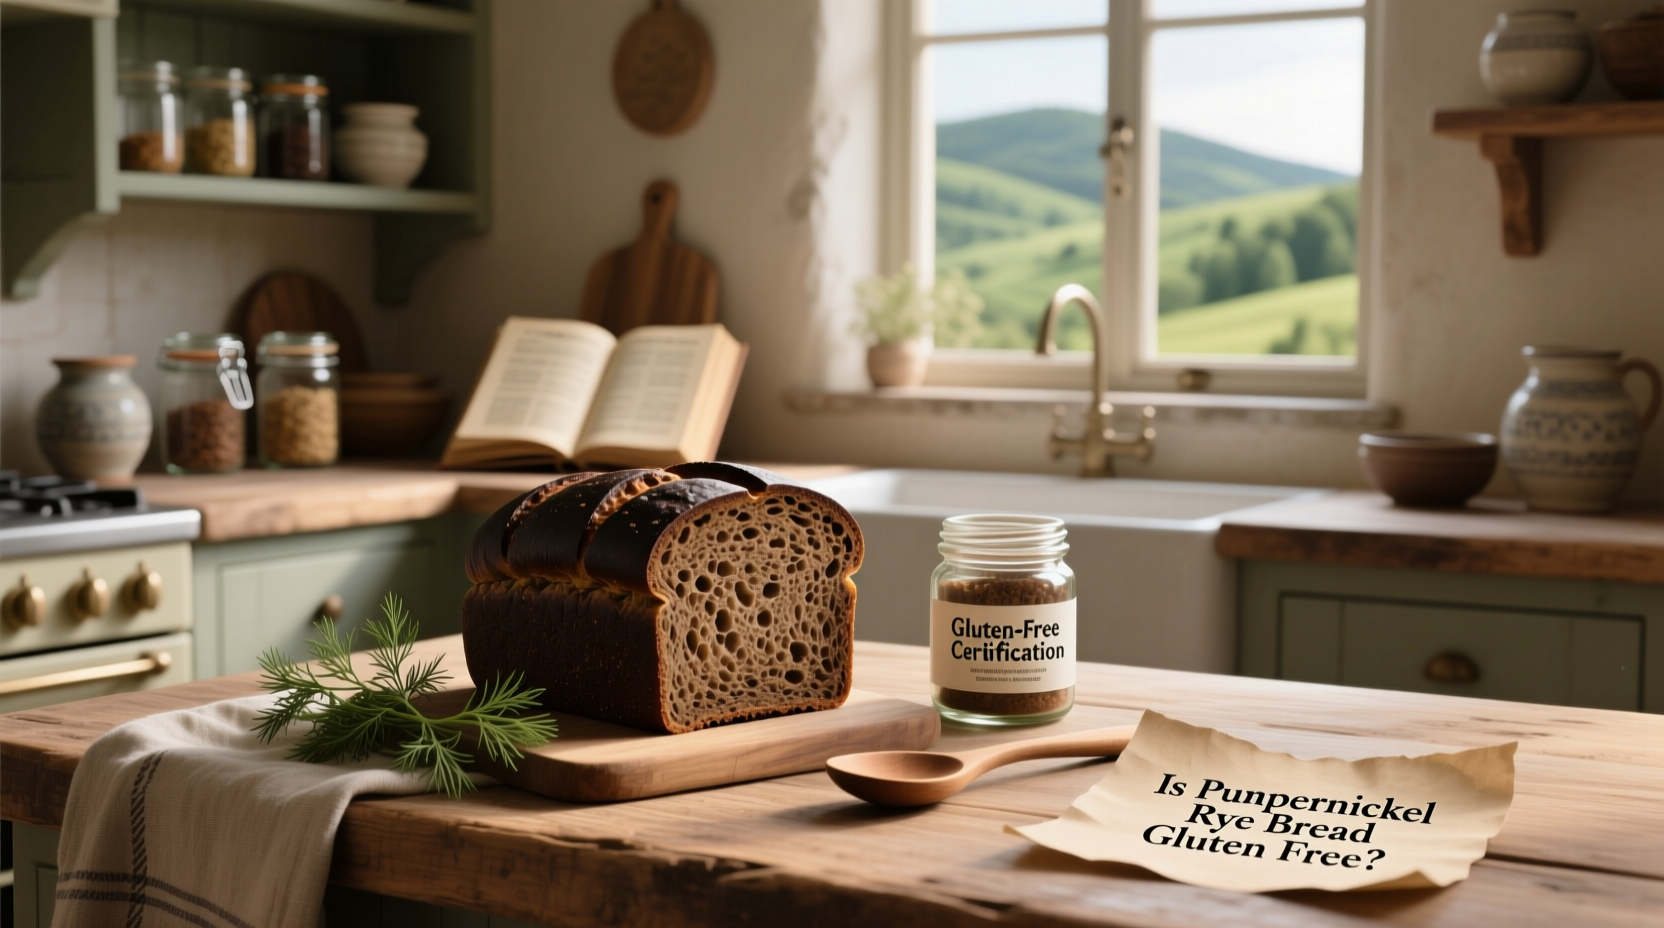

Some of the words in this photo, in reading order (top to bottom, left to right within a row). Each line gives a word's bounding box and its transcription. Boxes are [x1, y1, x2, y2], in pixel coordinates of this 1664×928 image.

[951, 617, 1060, 639] Gluten-Free
[1154, 773, 1187, 797] Is
[1195, 779, 1437, 824] Punpernickel
[1185, 803, 1255, 834] Rye
[1263, 813, 1376, 844] Bread
[1143, 824, 1265, 859] Gluten
[1277, 840, 1386, 871] Free?
